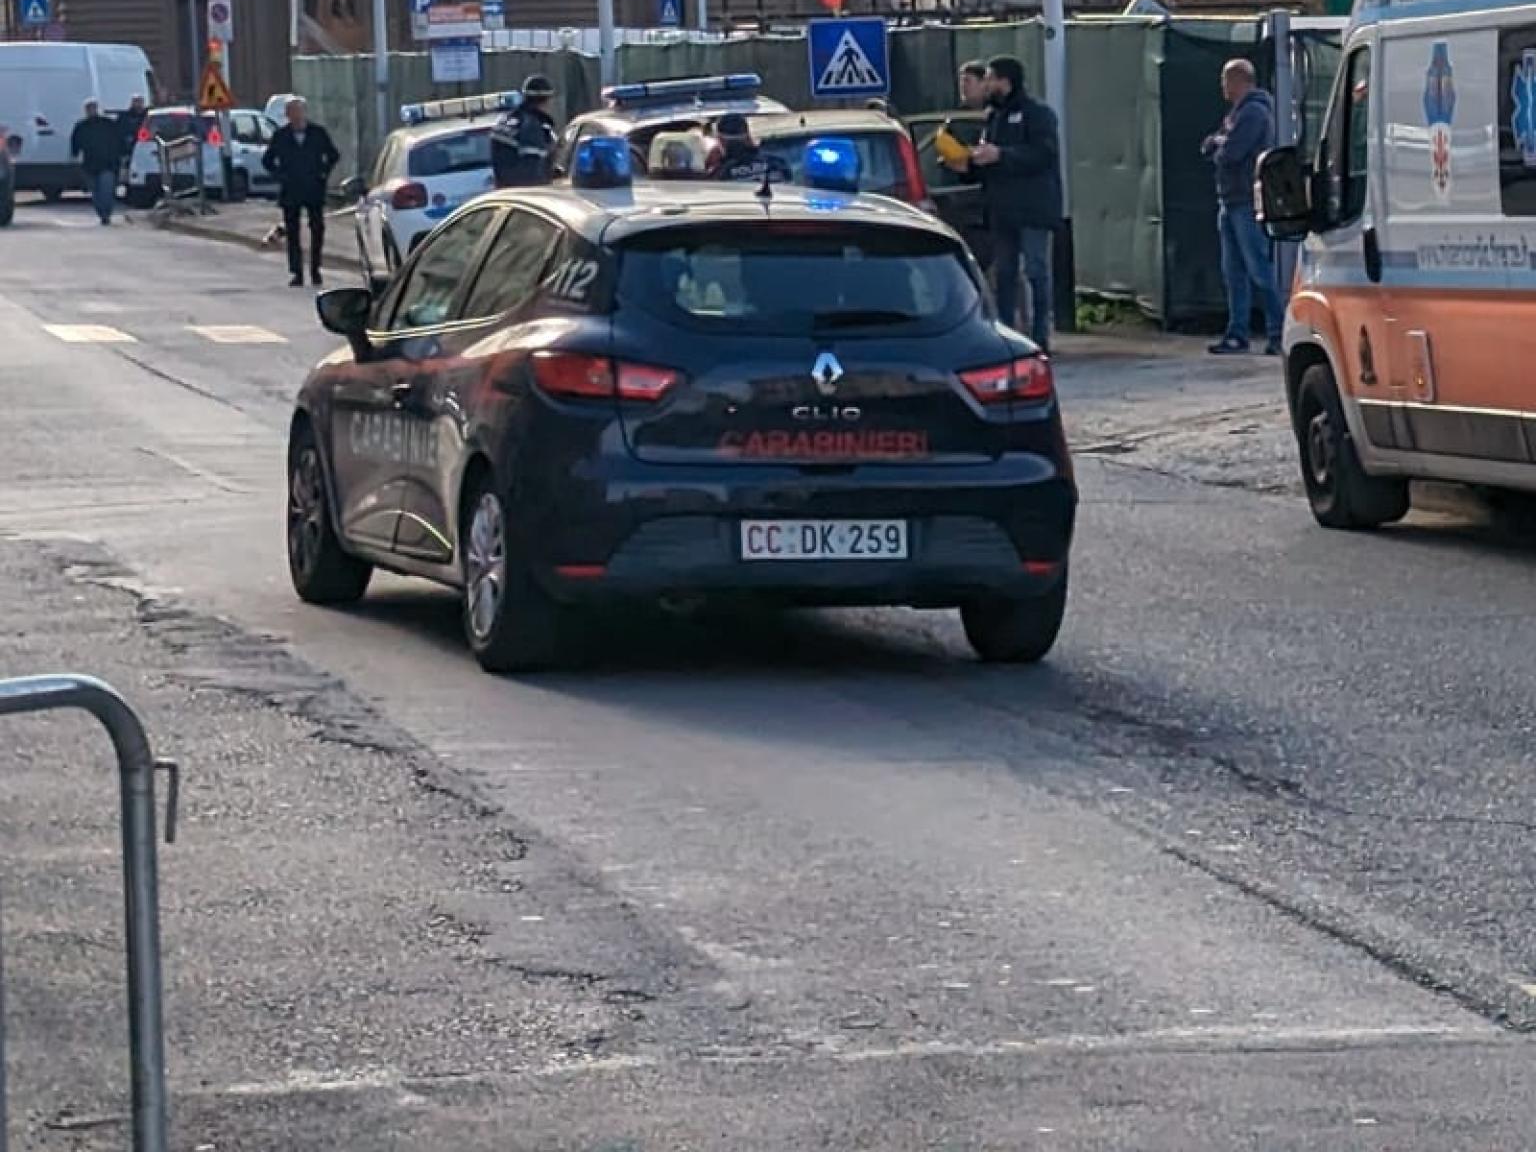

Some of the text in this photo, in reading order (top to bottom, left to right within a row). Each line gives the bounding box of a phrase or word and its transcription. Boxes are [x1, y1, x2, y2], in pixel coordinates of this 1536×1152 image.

[792, 406, 861, 420] CLIO
[719, 429, 930, 459] CARABINIERI
[747, 525, 901, 554] CC DK 259
